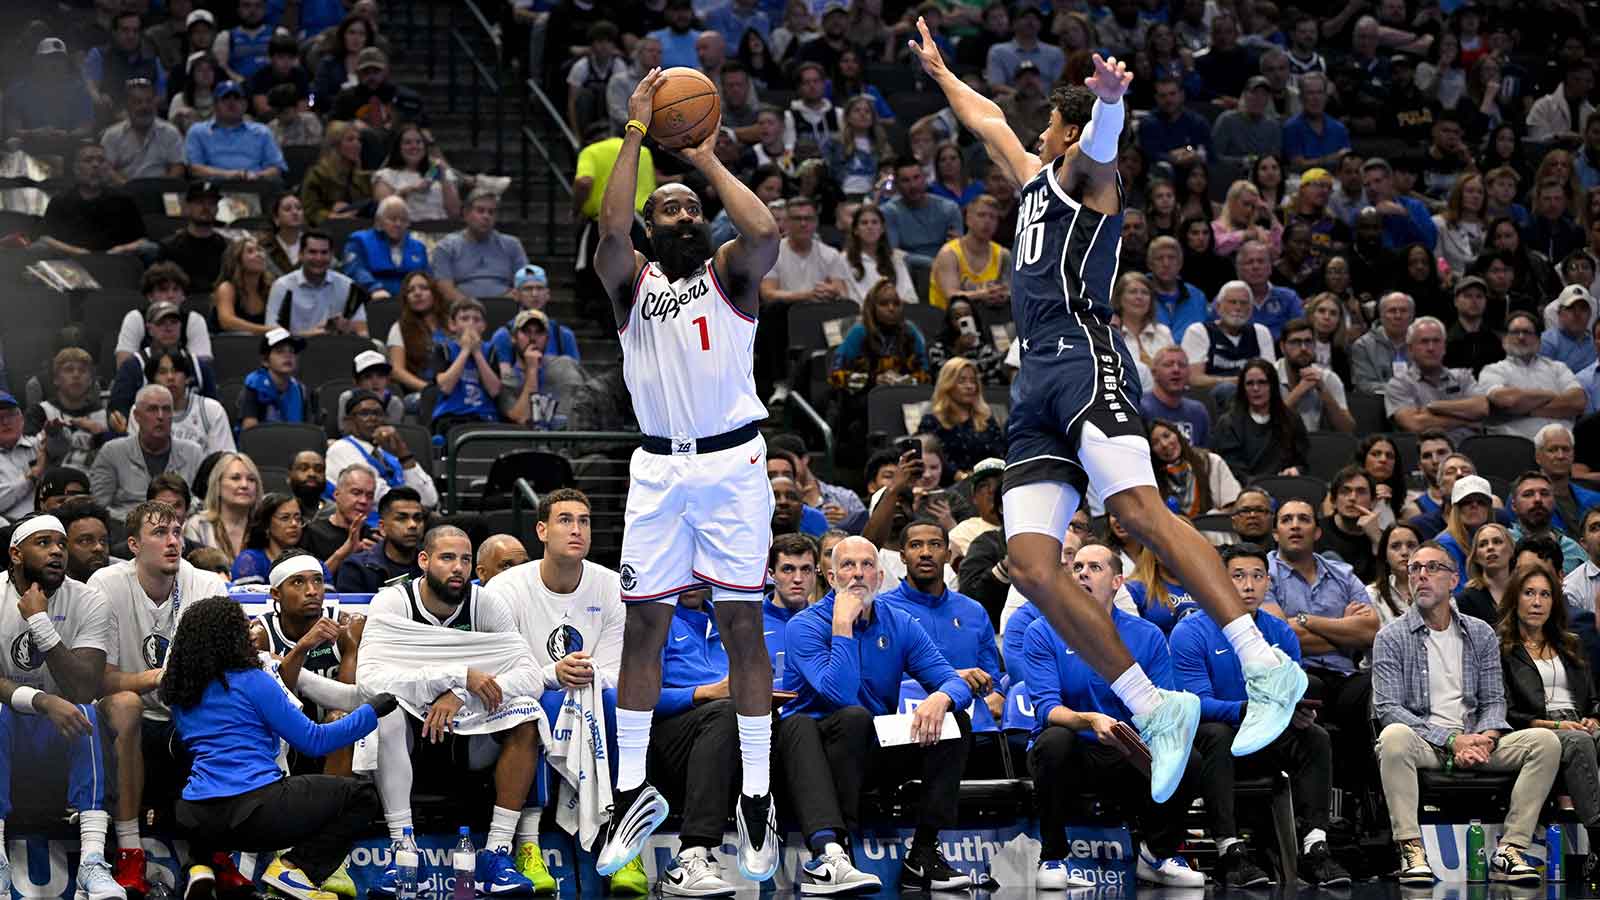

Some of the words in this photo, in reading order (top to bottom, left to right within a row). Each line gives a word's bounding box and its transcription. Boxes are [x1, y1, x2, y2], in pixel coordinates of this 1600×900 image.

[1015, 222, 1045, 271] 00
[692, 316, 711, 351] 1
[1067, 866, 1126, 885] enter
